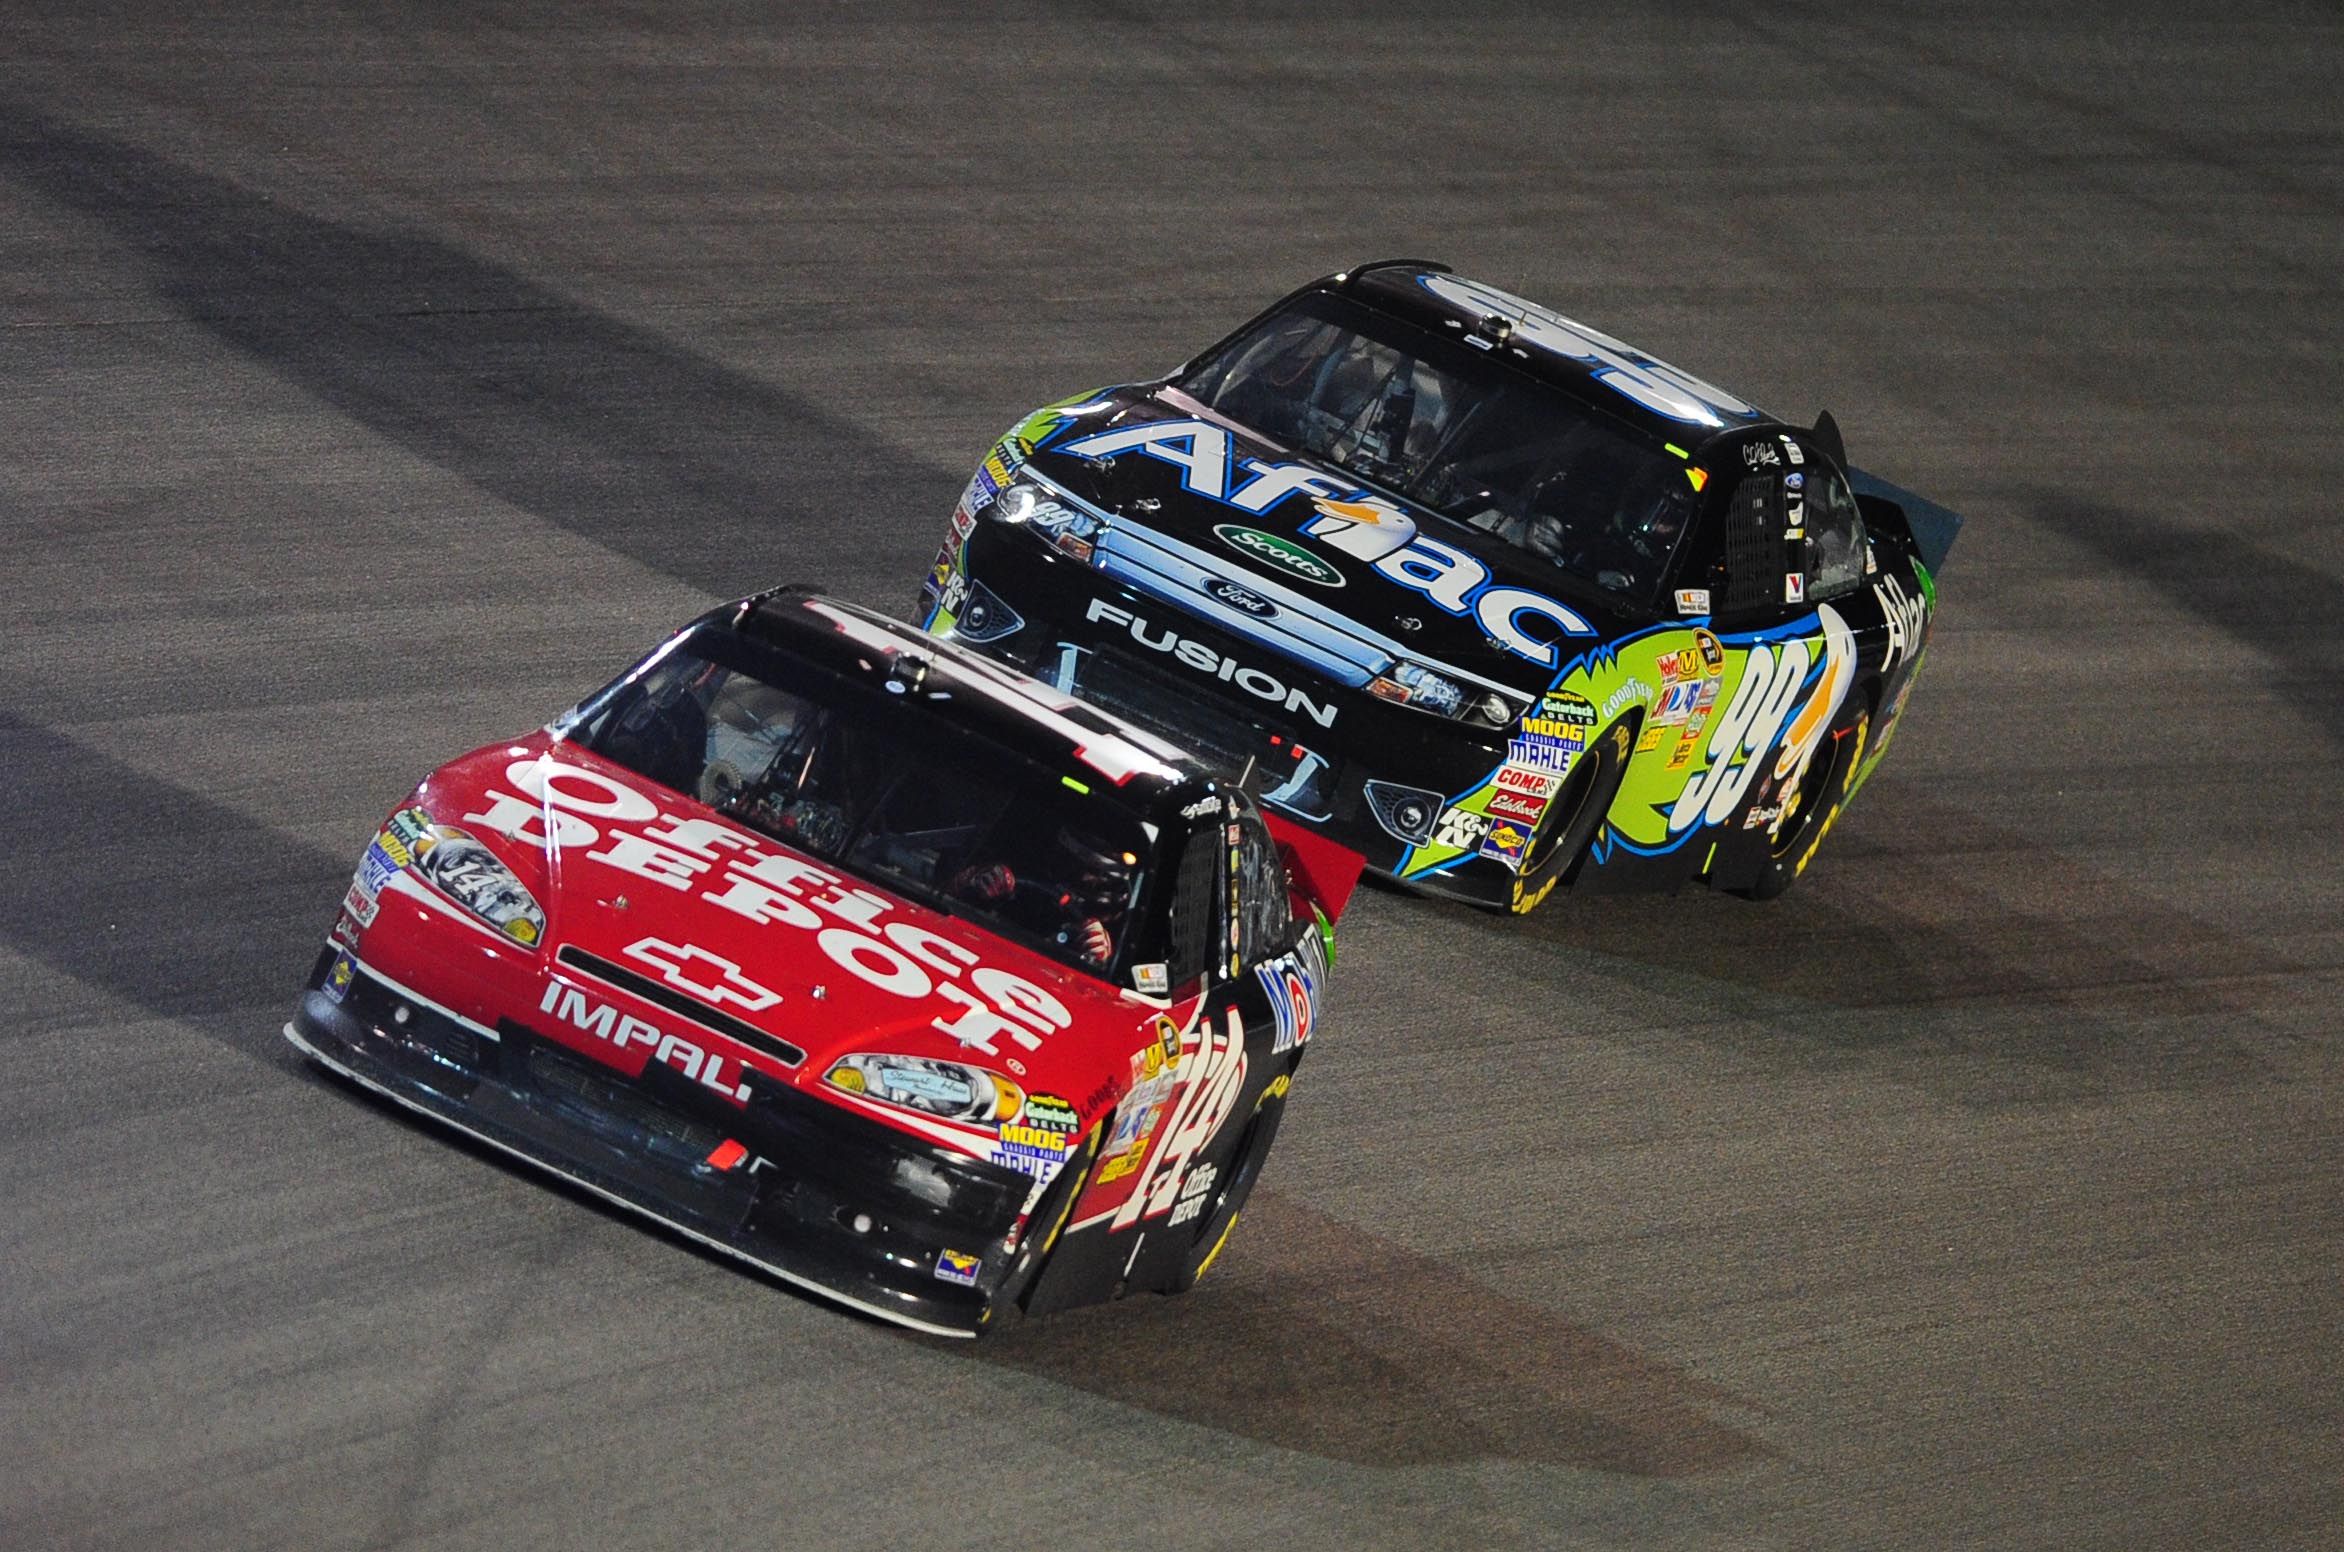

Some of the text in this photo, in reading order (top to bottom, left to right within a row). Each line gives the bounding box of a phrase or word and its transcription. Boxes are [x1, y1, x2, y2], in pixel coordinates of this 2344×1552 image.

[1054, 419, 1600, 668] Aflac
[1230, 532, 1329, 578] Scotts
[1217, 584, 1266, 612] Ford
[1087, 598, 1338, 729] FUSION
[1521, 716, 1585, 742] MOOG
[1667, 640, 1810, 834] 99
[1510, 741, 1571, 772] MAHLE
[1497, 768, 1546, 793] COMP
[1488, 830, 1525, 847] SUNOCO
[439, 860, 488, 897] 14
[505, 760, 1073, 1035] Office
[462, 790, 1042, 1057] DEPOT
[539, 979, 753, 1101] IMPAL
[1000, 1122, 1067, 1151] MOOG
